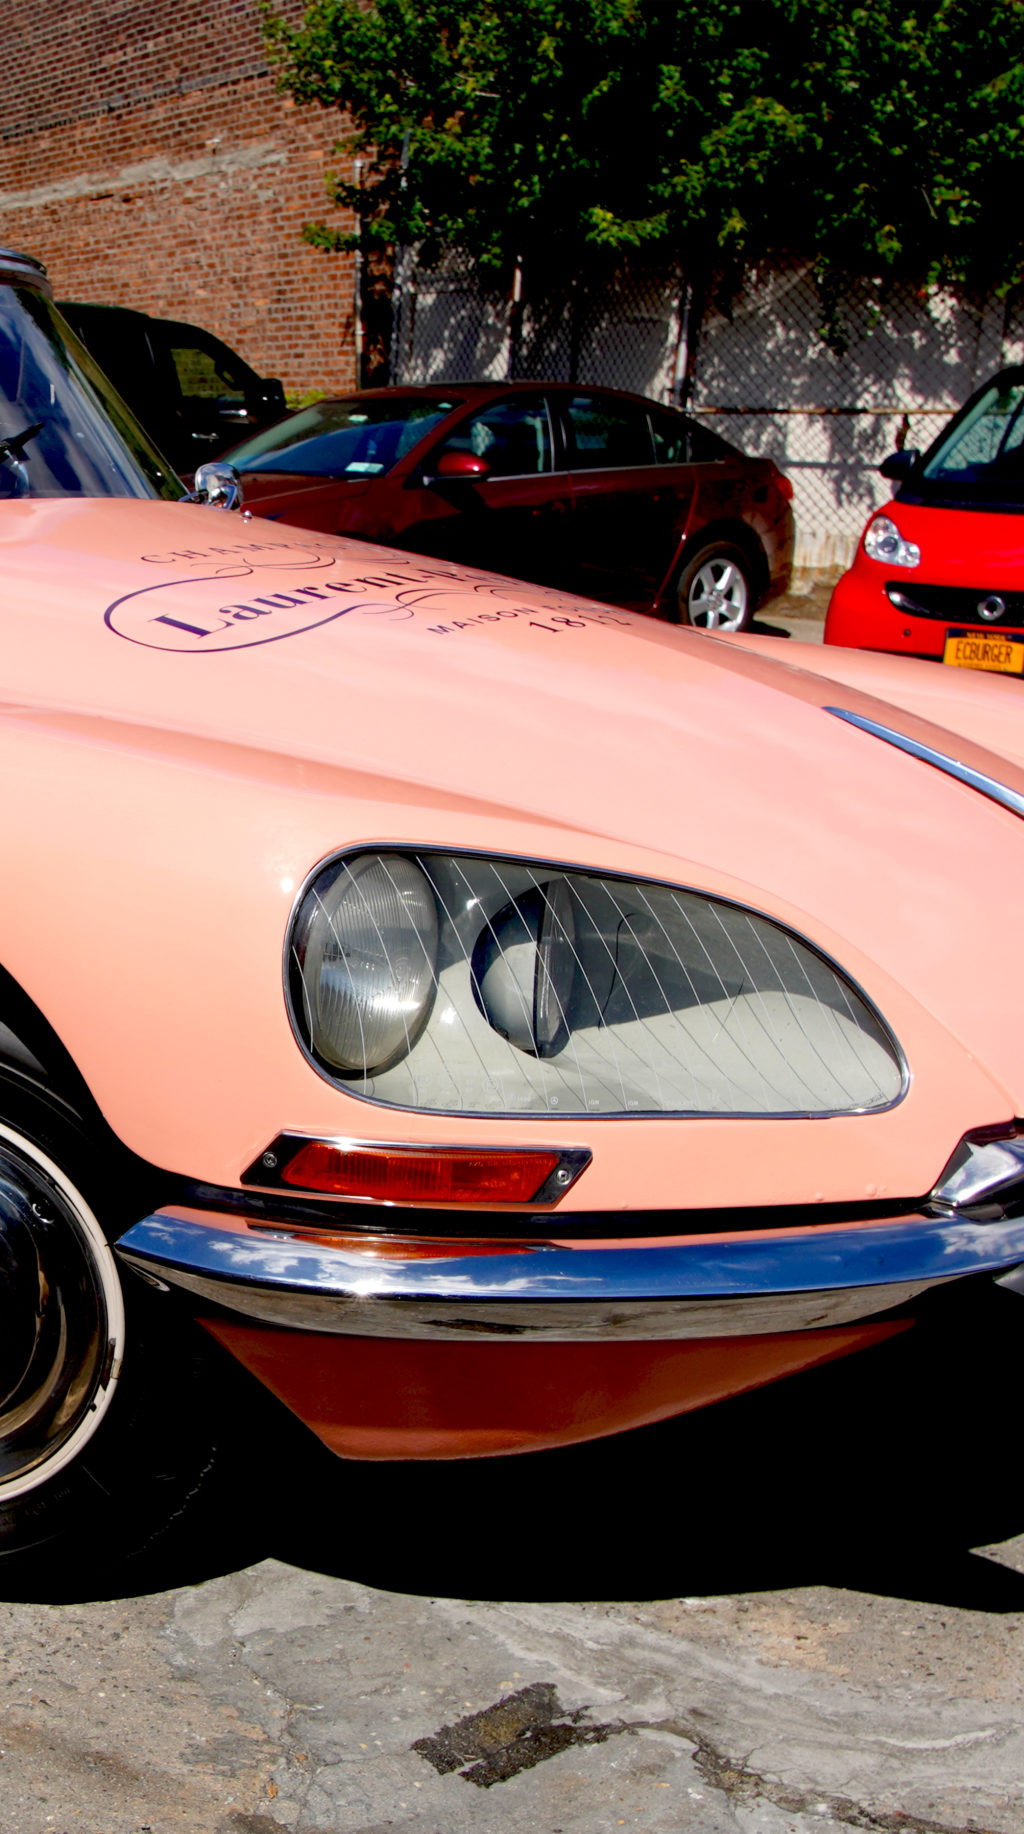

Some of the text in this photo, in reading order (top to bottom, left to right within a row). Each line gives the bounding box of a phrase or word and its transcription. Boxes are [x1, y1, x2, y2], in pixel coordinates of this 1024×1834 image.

[140, 542, 381, 564] CHAMP
[147, 566, 524, 640] Laurent-P
[426, 606, 540, 636] MAISON
[529, 614, 633, 633] 1812
[955, 640, 1013, 664] ECBURGER
